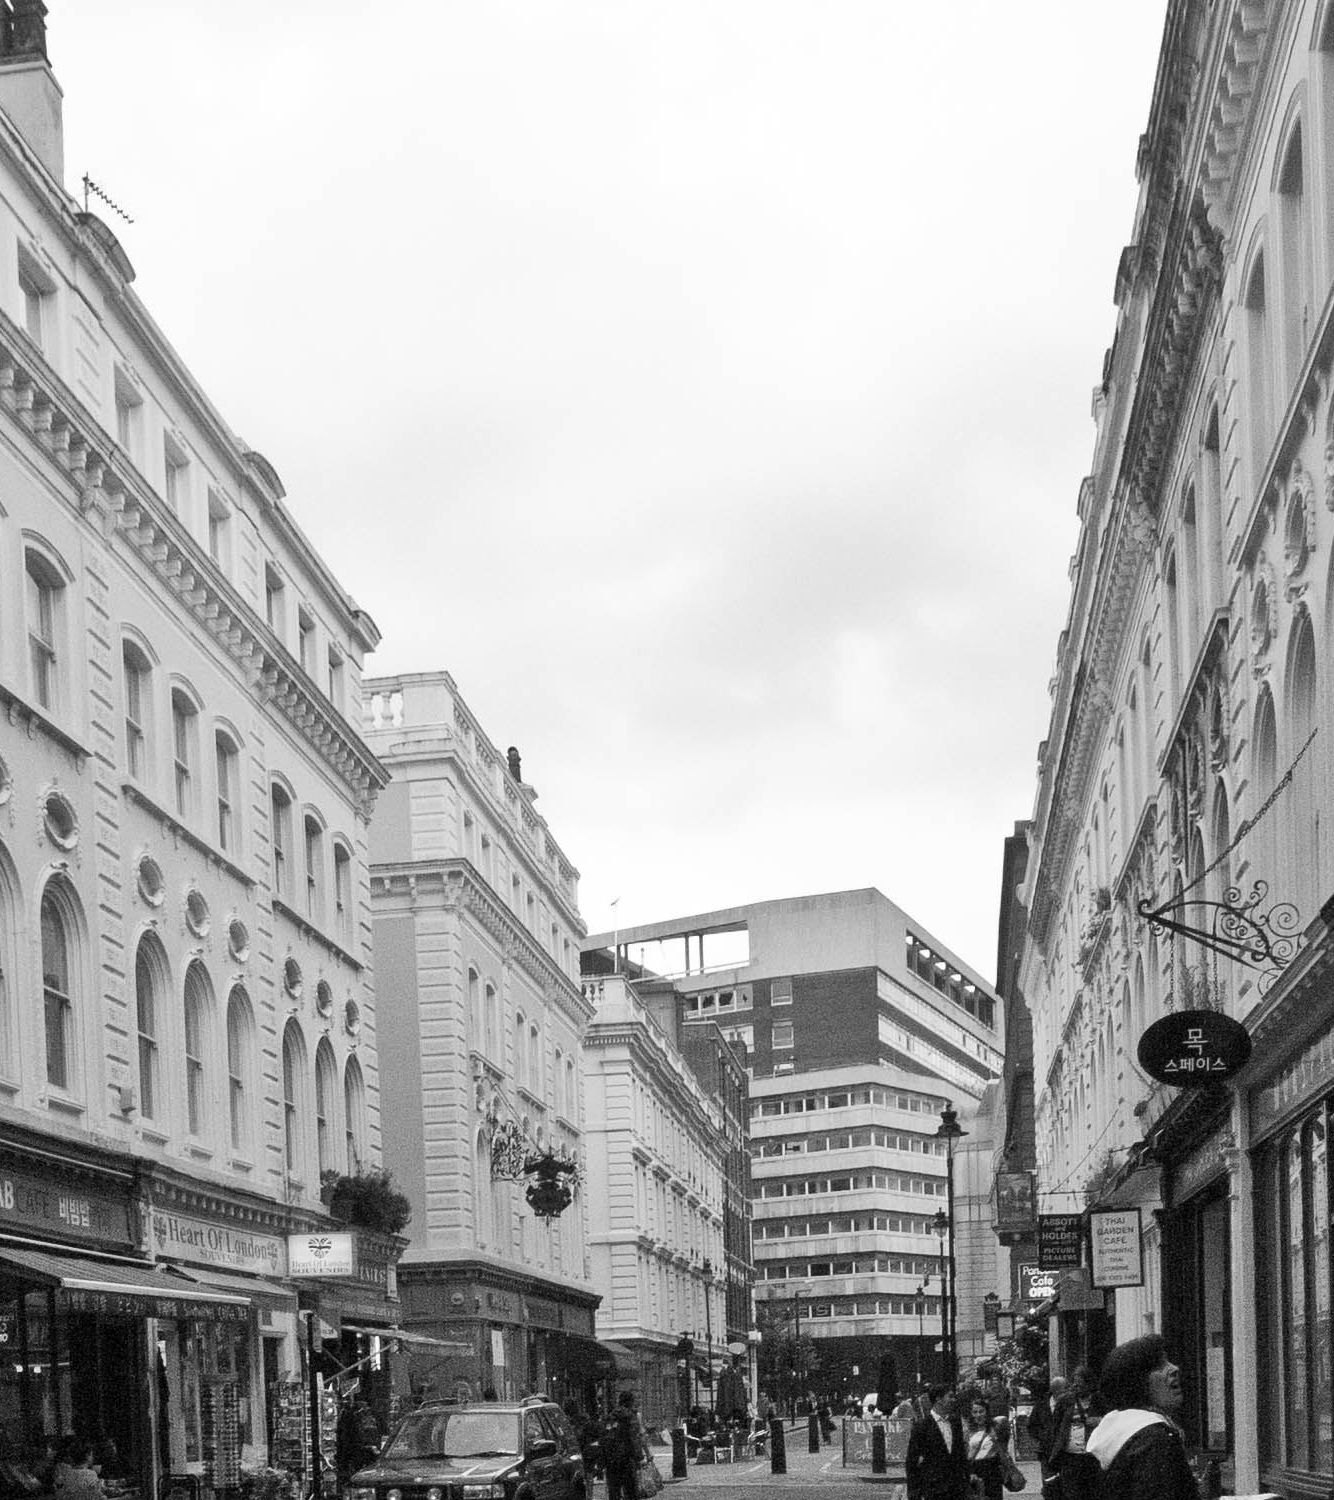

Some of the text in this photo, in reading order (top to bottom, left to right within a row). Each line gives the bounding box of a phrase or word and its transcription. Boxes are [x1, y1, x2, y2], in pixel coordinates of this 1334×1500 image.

[1182, 1028, 1209, 1056] 목
[1163, 1057, 1227, 1073] 스페이스
[1042, 1217, 1078, 1226] ABBOTT
[168, 1217, 269, 1260] Heart Of London
